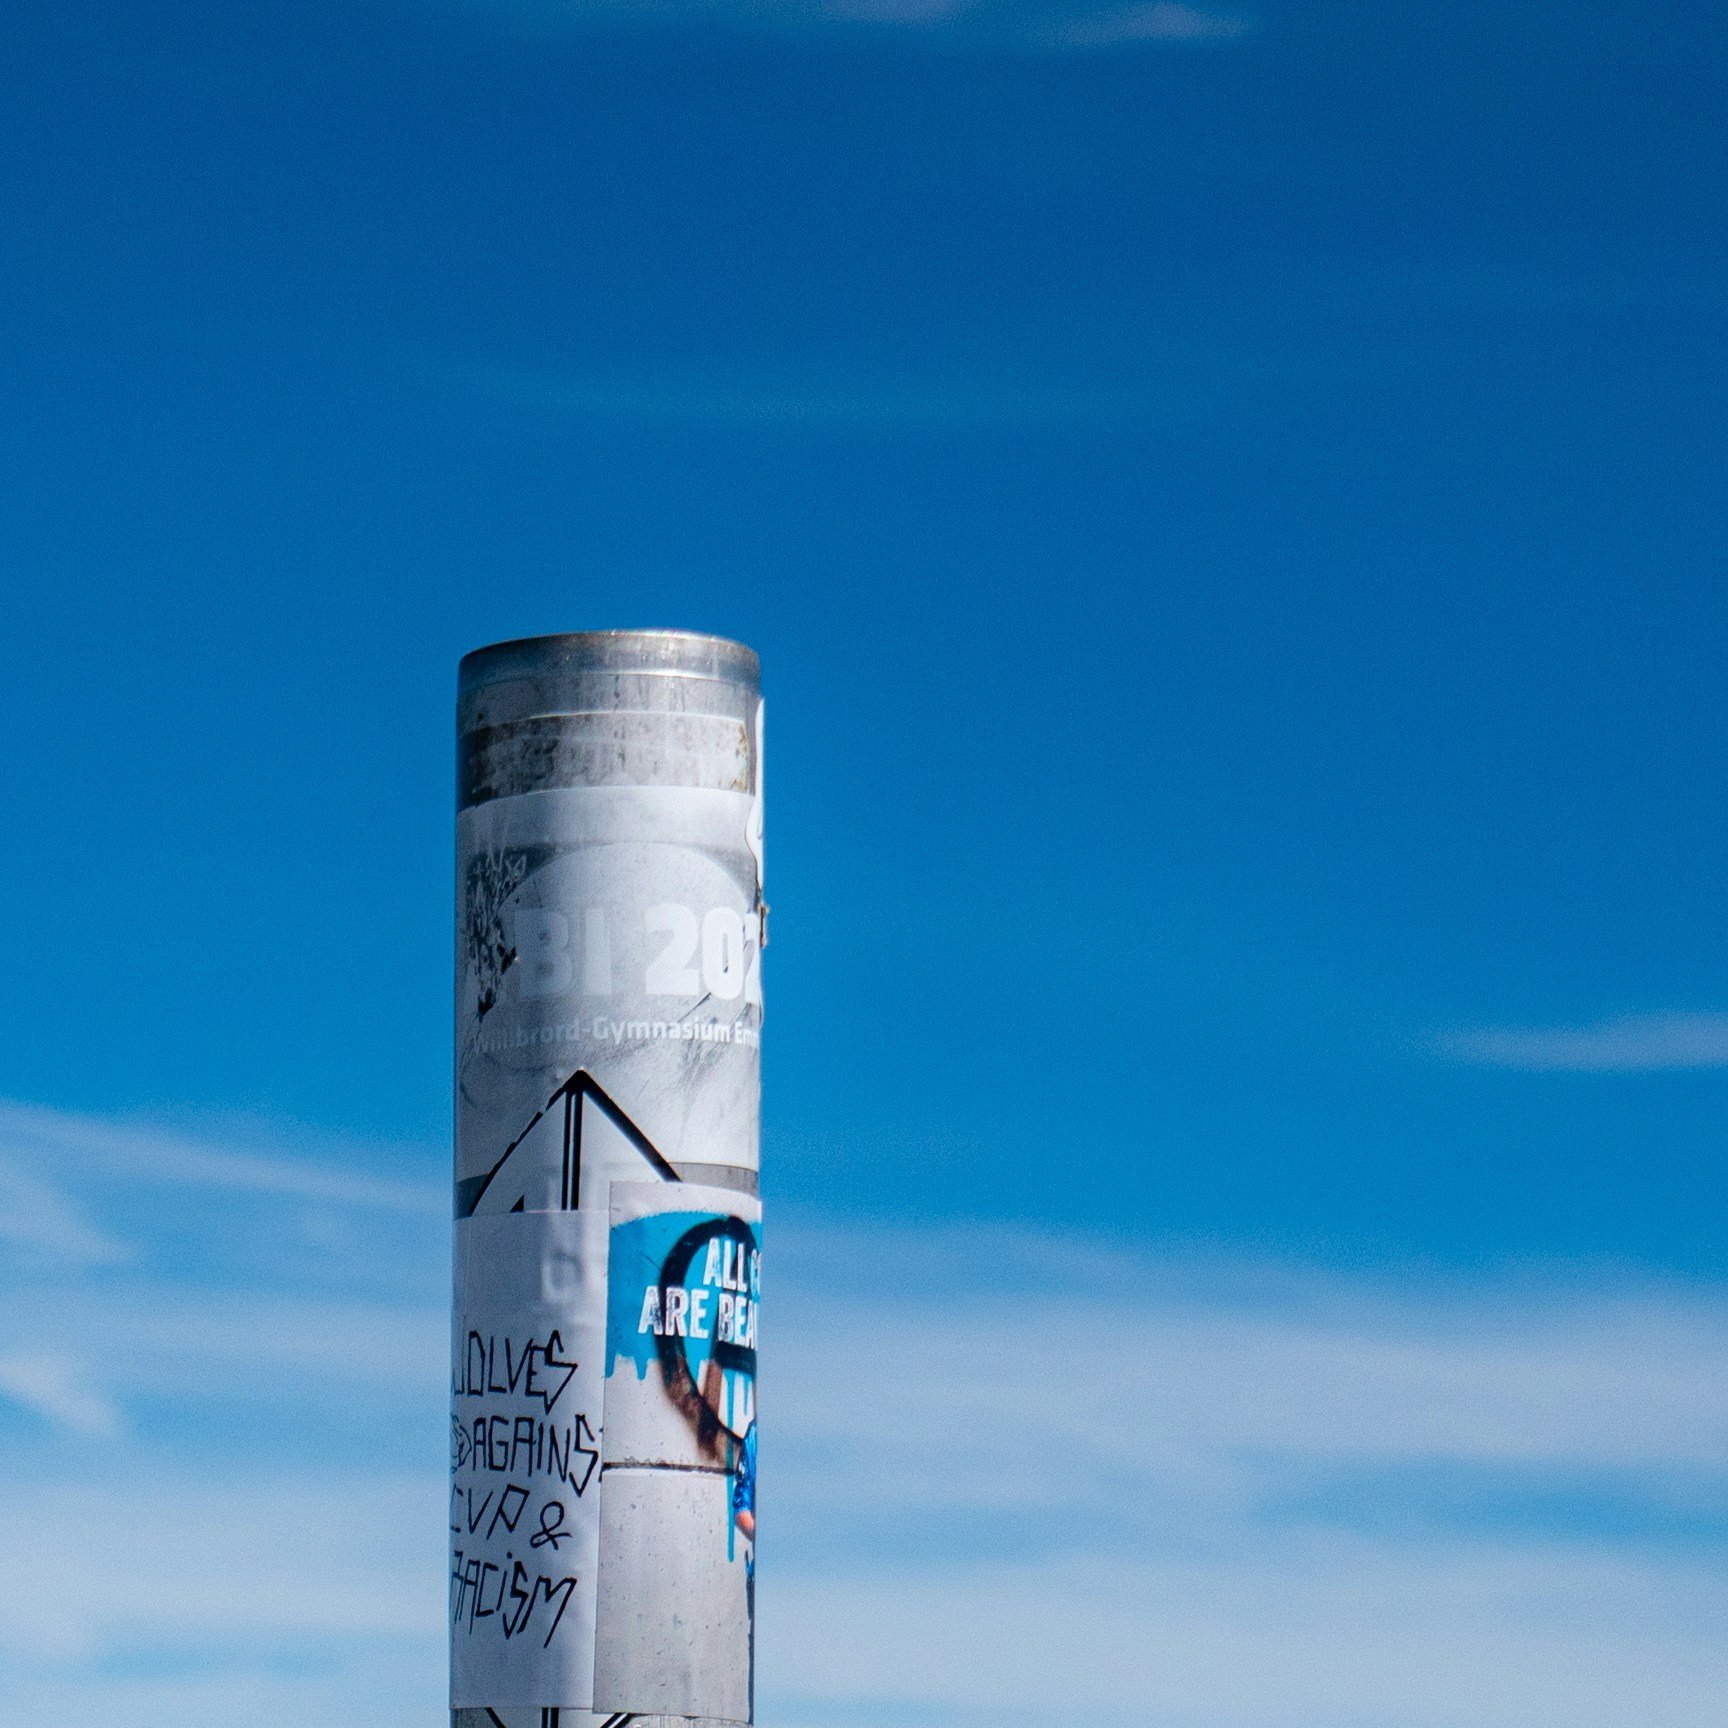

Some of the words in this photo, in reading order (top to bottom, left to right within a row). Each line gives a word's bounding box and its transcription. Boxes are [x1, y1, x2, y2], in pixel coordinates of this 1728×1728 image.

[702, 1236, 748, 1294] ALL
[637, 1284, 710, 1340] ARE
[716, 1291, 758, 1350] BEA
[472, 1413, 604, 1498] AGAINS
[529, 1500, 573, 1551] &
